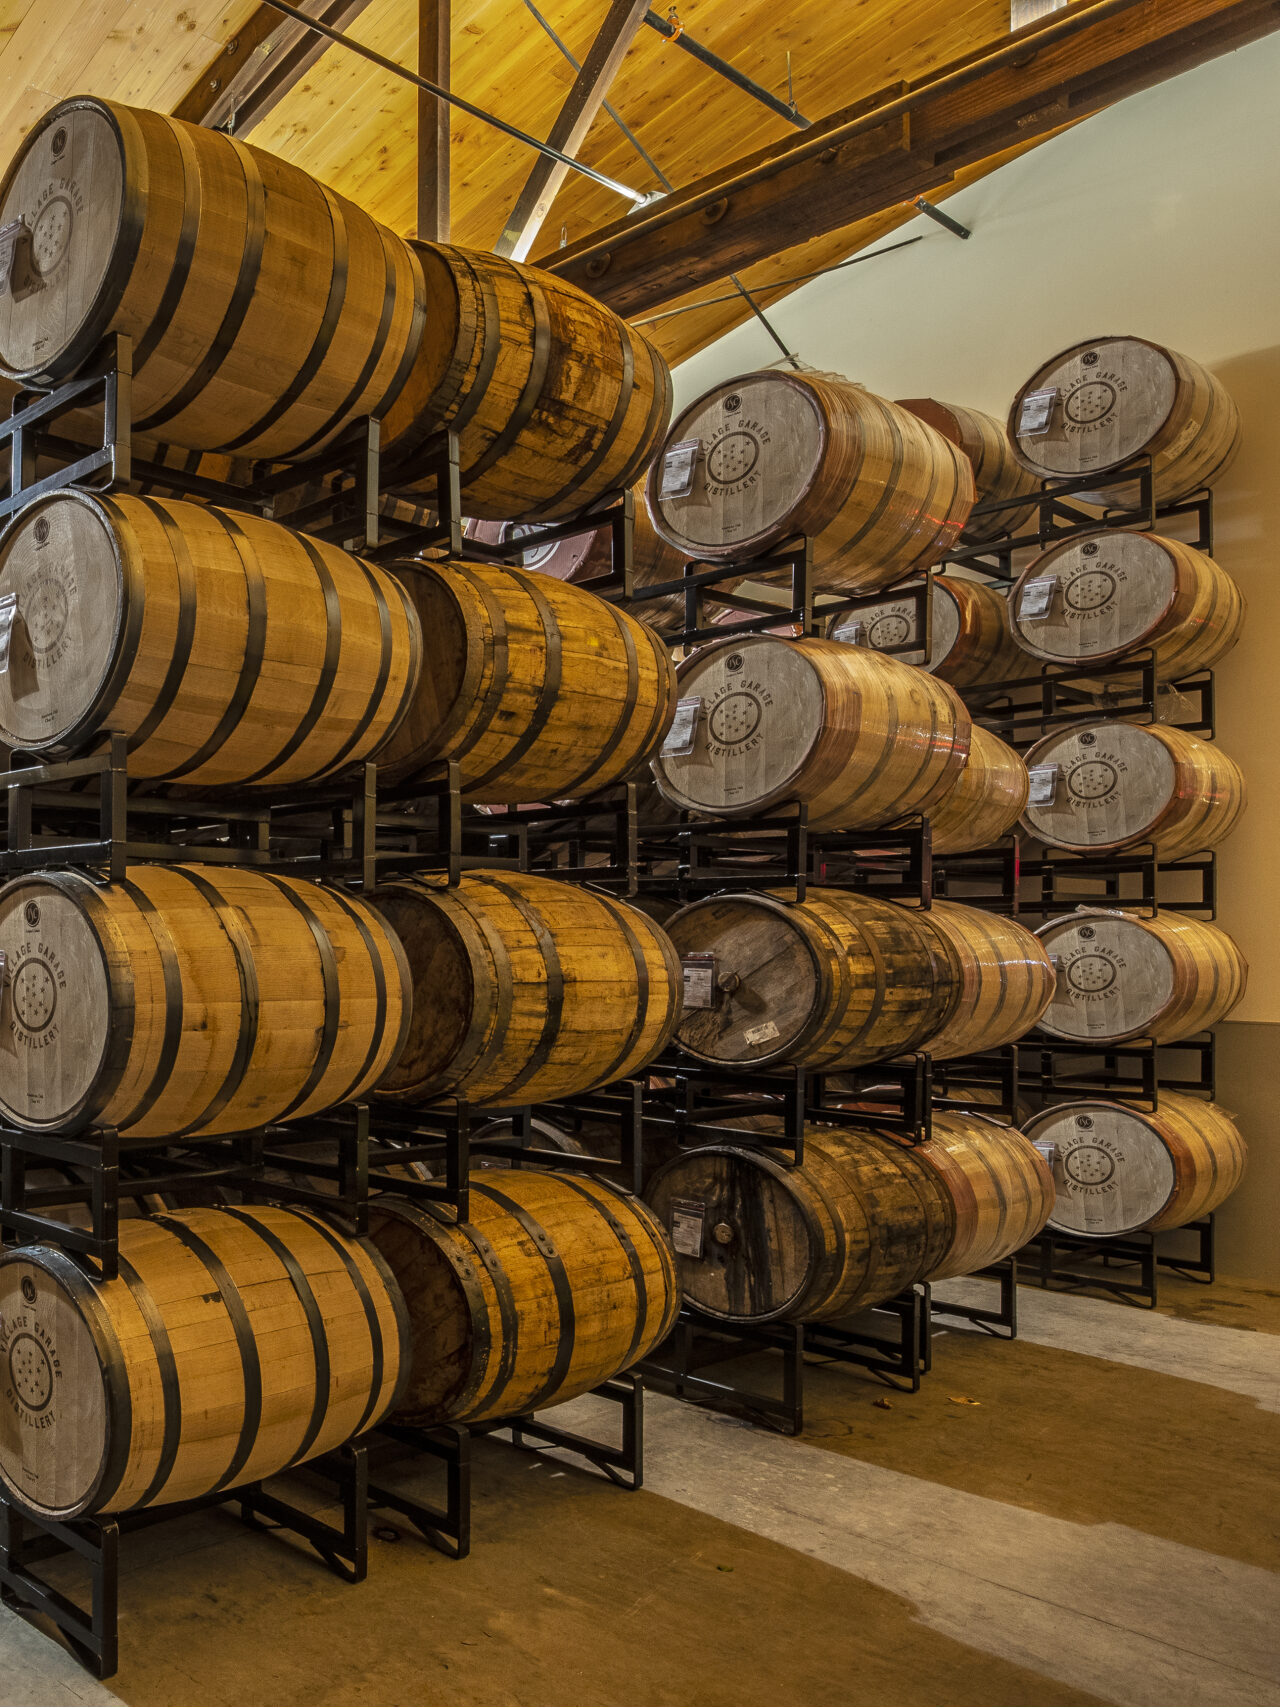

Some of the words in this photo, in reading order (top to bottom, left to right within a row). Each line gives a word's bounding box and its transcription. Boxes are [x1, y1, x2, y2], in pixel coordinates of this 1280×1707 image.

[59, 178, 84, 216] GARAGE
[1055, 374, 1088, 407] VILLAGE
[1096, 371, 1128, 393] GARAGE
[1061, 412, 1119, 433] DISTILLERY
[696, 423, 730, 463] VILLAGE
[738, 419, 771, 446] GARAGE
[704, 471, 762, 496] DISTILLERY
[1055, 564, 1088, 595] VILLAGE
[1096, 562, 1128, 583] GARAGE
[1061, 601, 1118, 620] DISTILLERY
[23, 633, 72, 669] DISTILLERY
[699, 682, 733, 721] VILLAGE
[740, 680, 774, 708] GARAGE
[704, 732, 764, 757] DISTILLERY
[1058, 753, 1087, 782] VILLAGE
[1095, 751, 1129, 773] GARAGE
[1066, 791, 1122, 809] DISTILLERY
[4, 942, 32, 988] VILLAGE
[38, 943, 67, 989] GARAGE
[1056, 946, 1087, 973] VILLAGE
[1094, 946, 1127, 969] GARAGE
[1066, 985, 1121, 1002] DISTILLERY
[10, 1020, 60, 1049] DISTILLERY
[1055, 1136, 1084, 1162] VILLAGE
[1092, 1137, 1126, 1163] GARAGE
[1063, 1179, 1119, 1195] DISTILLERY
[0, 1316, 28, 1354] VILLAGE
[34, 1322, 63, 1379] GARAGE
[6, 1388, 56, 1430] DISTILLERY
